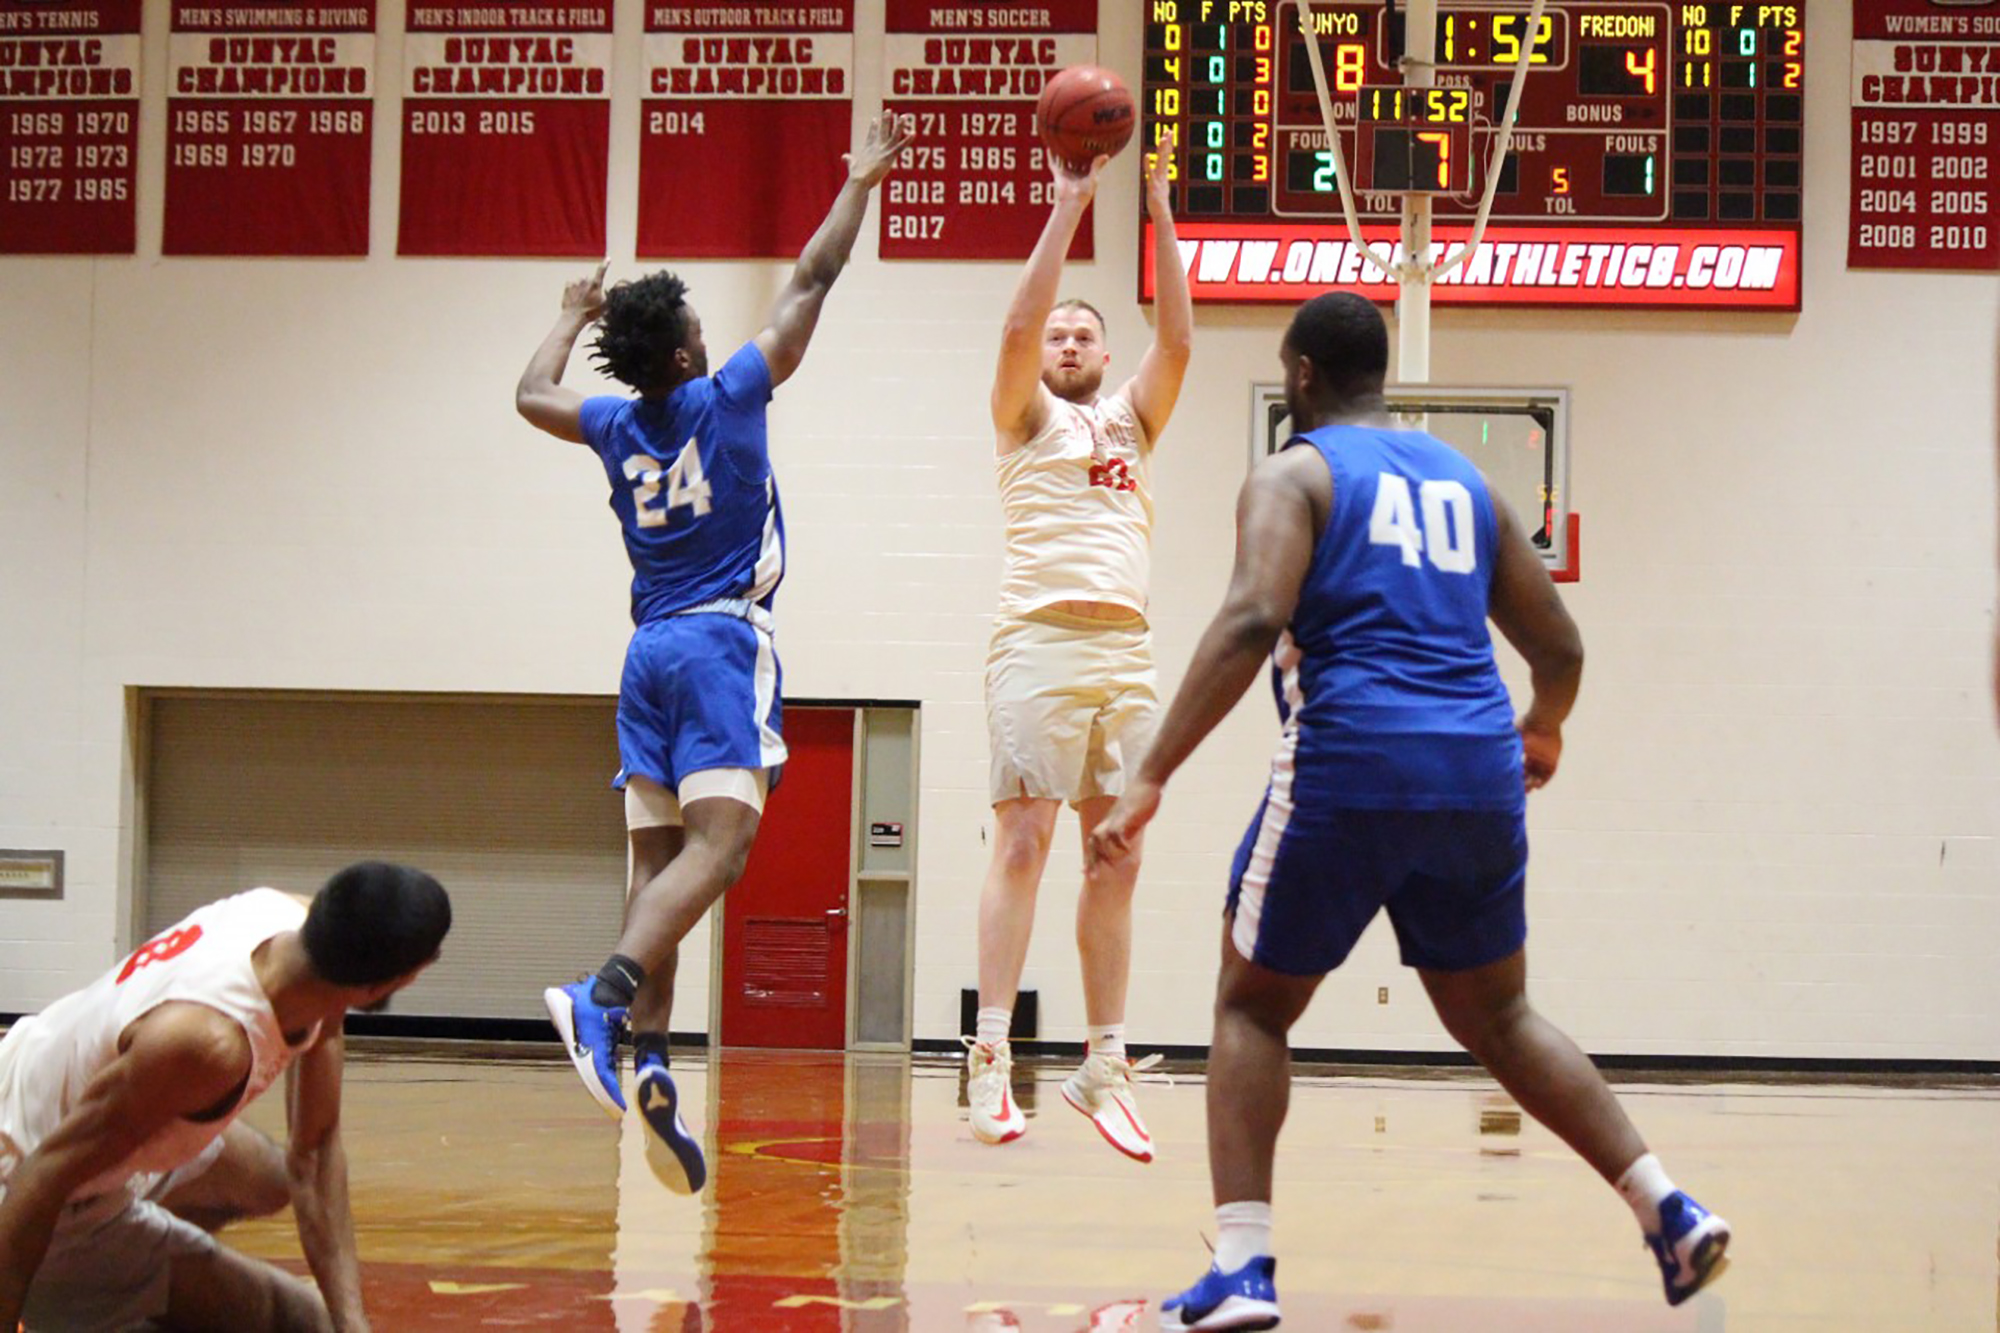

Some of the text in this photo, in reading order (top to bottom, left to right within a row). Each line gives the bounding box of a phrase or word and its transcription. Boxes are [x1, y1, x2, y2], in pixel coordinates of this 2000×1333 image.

[37, 11, 99, 28] TENNIS
[180, 8, 368, 25] MEN'S SWIMMING & DIVING
[414, 8, 605, 25] MEN'S INDOOR TRACK & FIELD
[654, 9, 843, 25] MEN'S OUTDOOR TRACK & FIELD
[930, 9, 1050, 26] MEN'S SOCCER
[1154, 2, 1266, 23] NO F PTS
[1682, 6, 1797, 27] NO F PTS
[1886, 15, 1968, 33] WOMEN'S
[1165, 25, 1270, 50] 0 1 0
[1580, 16, 1655, 37] FREDONI
[209, 38, 336, 63] SUNYAC
[444, 38, 573, 63] SUNYAC
[682, 38, 813, 64] SUNYAC
[924, 39, 1056, 65] SUNYAC
[1685, 29, 1801, 56] 10 0 2
[1165, 56, 1270, 83] 4 0 3
[1336, 44, 1365, 91] 8
[1625, 48, 1656, 94] 4
[1685, 62, 1801, 88] 11 1 2
[0, 68, 131, 95] MPIONS
[177, 67, 366, 93] CHAMPIONS
[413, 67, 604, 93] CHAMPIONS
[651, 68, 845, 94] CHAMPIONS
[893, 69, 1066, 95] CHAMPIO
[1437, 75, 1470, 88] POSS
[1862, 75, 2000, 103] CHAMPI
[1155, 89, 1180, 115] 10
[1218, 90, 1225, 115] 1
[1254, 89, 1269, 115] 0
[1566, 105, 1623, 122] BONUS
[11, 112, 129, 135] 1969 1970
[175, 111, 363, 133] 1965 1967 1968
[411, 112, 534, 133] 2013 2015
[650, 112, 704, 134] 2014
[961, 113, 1016, 136] 1972
[1860, 121, 1988, 145] 1997 1999
[1207, 121, 1223, 148] 0
[1252, 122, 1268, 148] 2
[1605, 136, 1658, 152] FOULS
[11, 146, 128, 168] 1972 1973
[174, 144, 295, 166] 1969 1970
[960, 147, 1016, 169] 1985
[1206, 153, 1223, 181] 0
[1252, 155, 1268, 181] 3
[1417, 132, 1450, 188] 7
[1860, 155, 1988, 179] 2001 2002
[1313, 151, 1336, 191] 2
[1553, 168, 1569, 193] 5
[1645, 156, 1654, 194] 1
[9, 179, 127, 201] 1977 1985
[890, 181, 945, 203] 2012
[960, 181, 1015, 204] 2014
[1860, 190, 1988, 214] 2004 2005
[1365, 196, 1395, 212] TOL
[1545, 197, 1577, 214] TOL
[889, 215, 945, 238] 2017
[1859, 225, 1987, 249] 2008 2010
[622, 435, 713, 528] 24
[1368, 471, 1477, 575] 40
